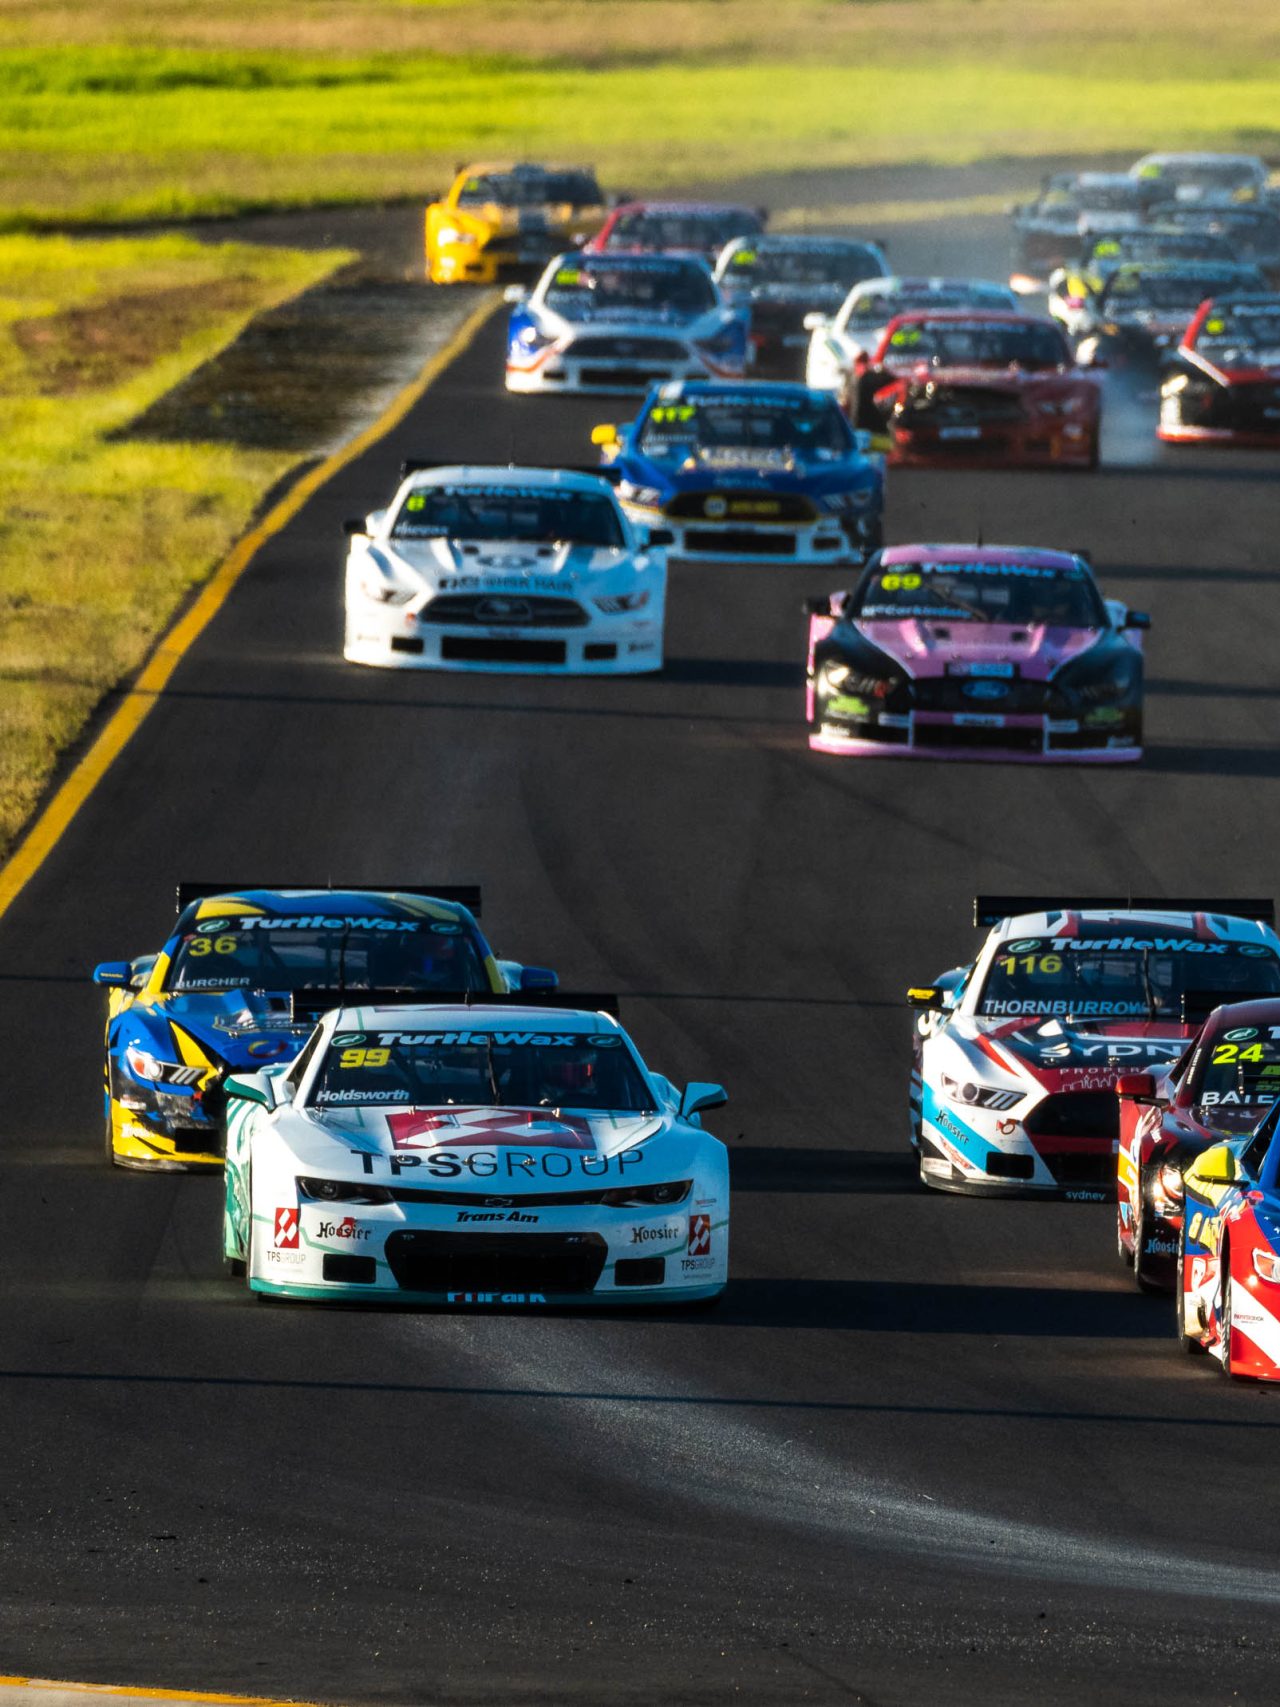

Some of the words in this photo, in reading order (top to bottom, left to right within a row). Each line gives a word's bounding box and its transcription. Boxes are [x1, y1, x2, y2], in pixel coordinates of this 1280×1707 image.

[240, 916, 419, 932] TurtleWax
[189, 936, 238, 957] 36
[1051, 937, 1229, 954] TurtleWax
[1000, 955, 1063, 976] 116
[175, 976, 250, 988] BURCHER
[984, 1000, 1151, 1016] THORNBURROW
[378, 1032, 576, 1046] TurtleWax
[340, 1049, 391, 1068] 99
[1212, 1043, 1264, 1065] 24
[316, 1089, 410, 1102] Holdsworth
[350, 1150, 644, 1178] TPSGROUP
[456, 1211, 505, 1223] Trans
[509, 1212, 540, 1223] Am
[629, 1224, 680, 1243] Hoosier
